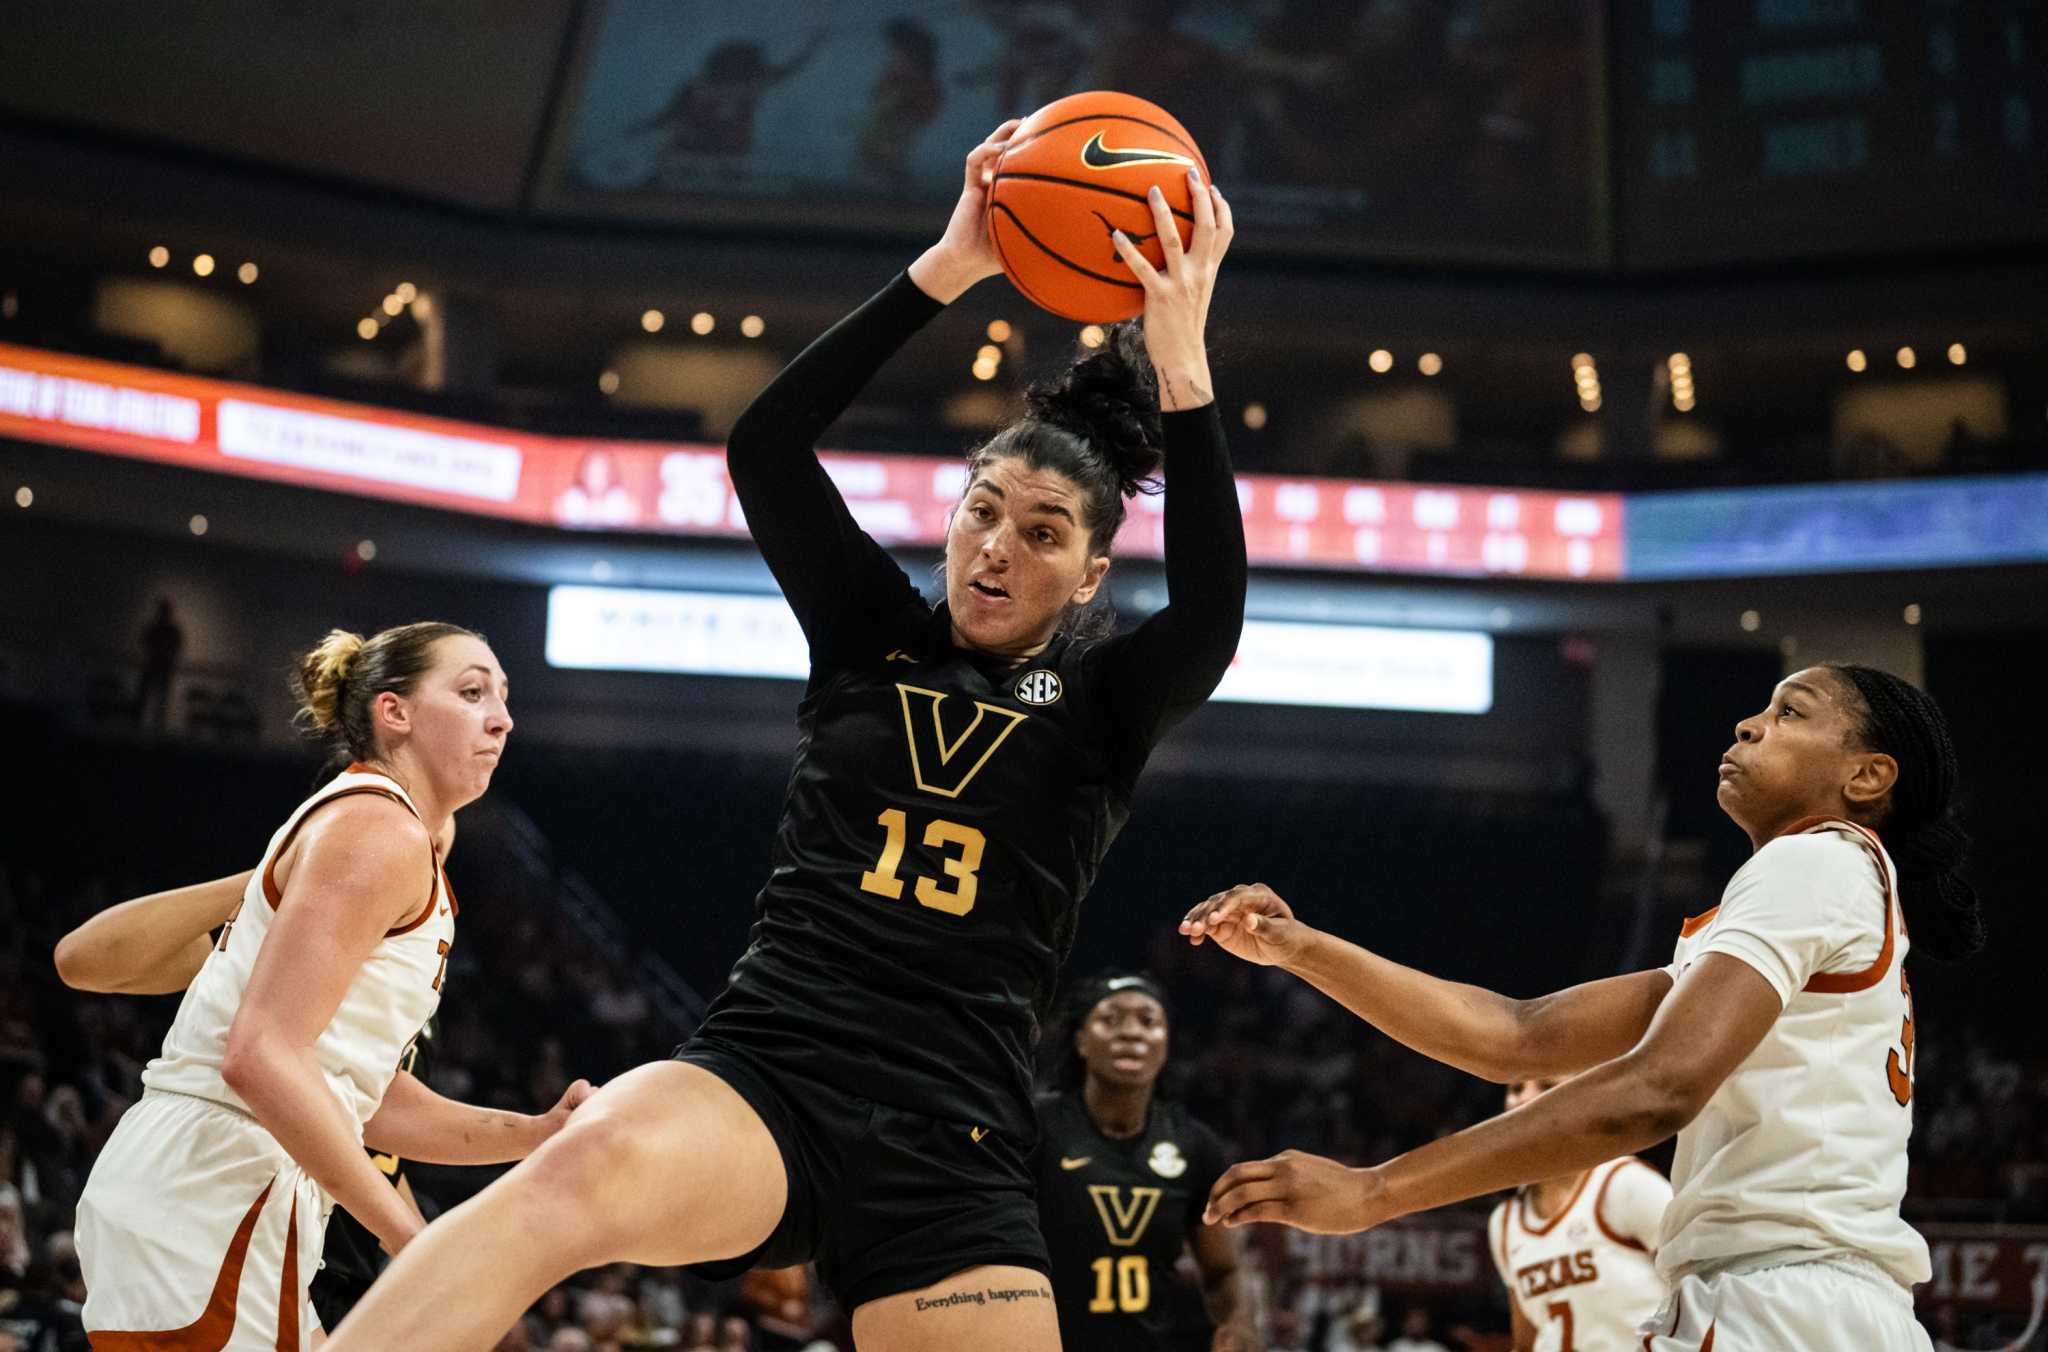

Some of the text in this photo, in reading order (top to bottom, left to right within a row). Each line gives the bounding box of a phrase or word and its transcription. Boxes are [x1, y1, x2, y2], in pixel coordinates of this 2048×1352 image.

[1018, 672, 1059, 703] SEC
[895, 683, 1030, 799] V
[860, 807, 987, 918] 13
[1087, 1185, 1163, 1246] V
[915, 1290, 986, 1312] Everything
[987, 1288, 1040, 1303] happens
[1088, 1256, 1151, 1314] 10
[1517, 1248, 1599, 1299] TEXAS
